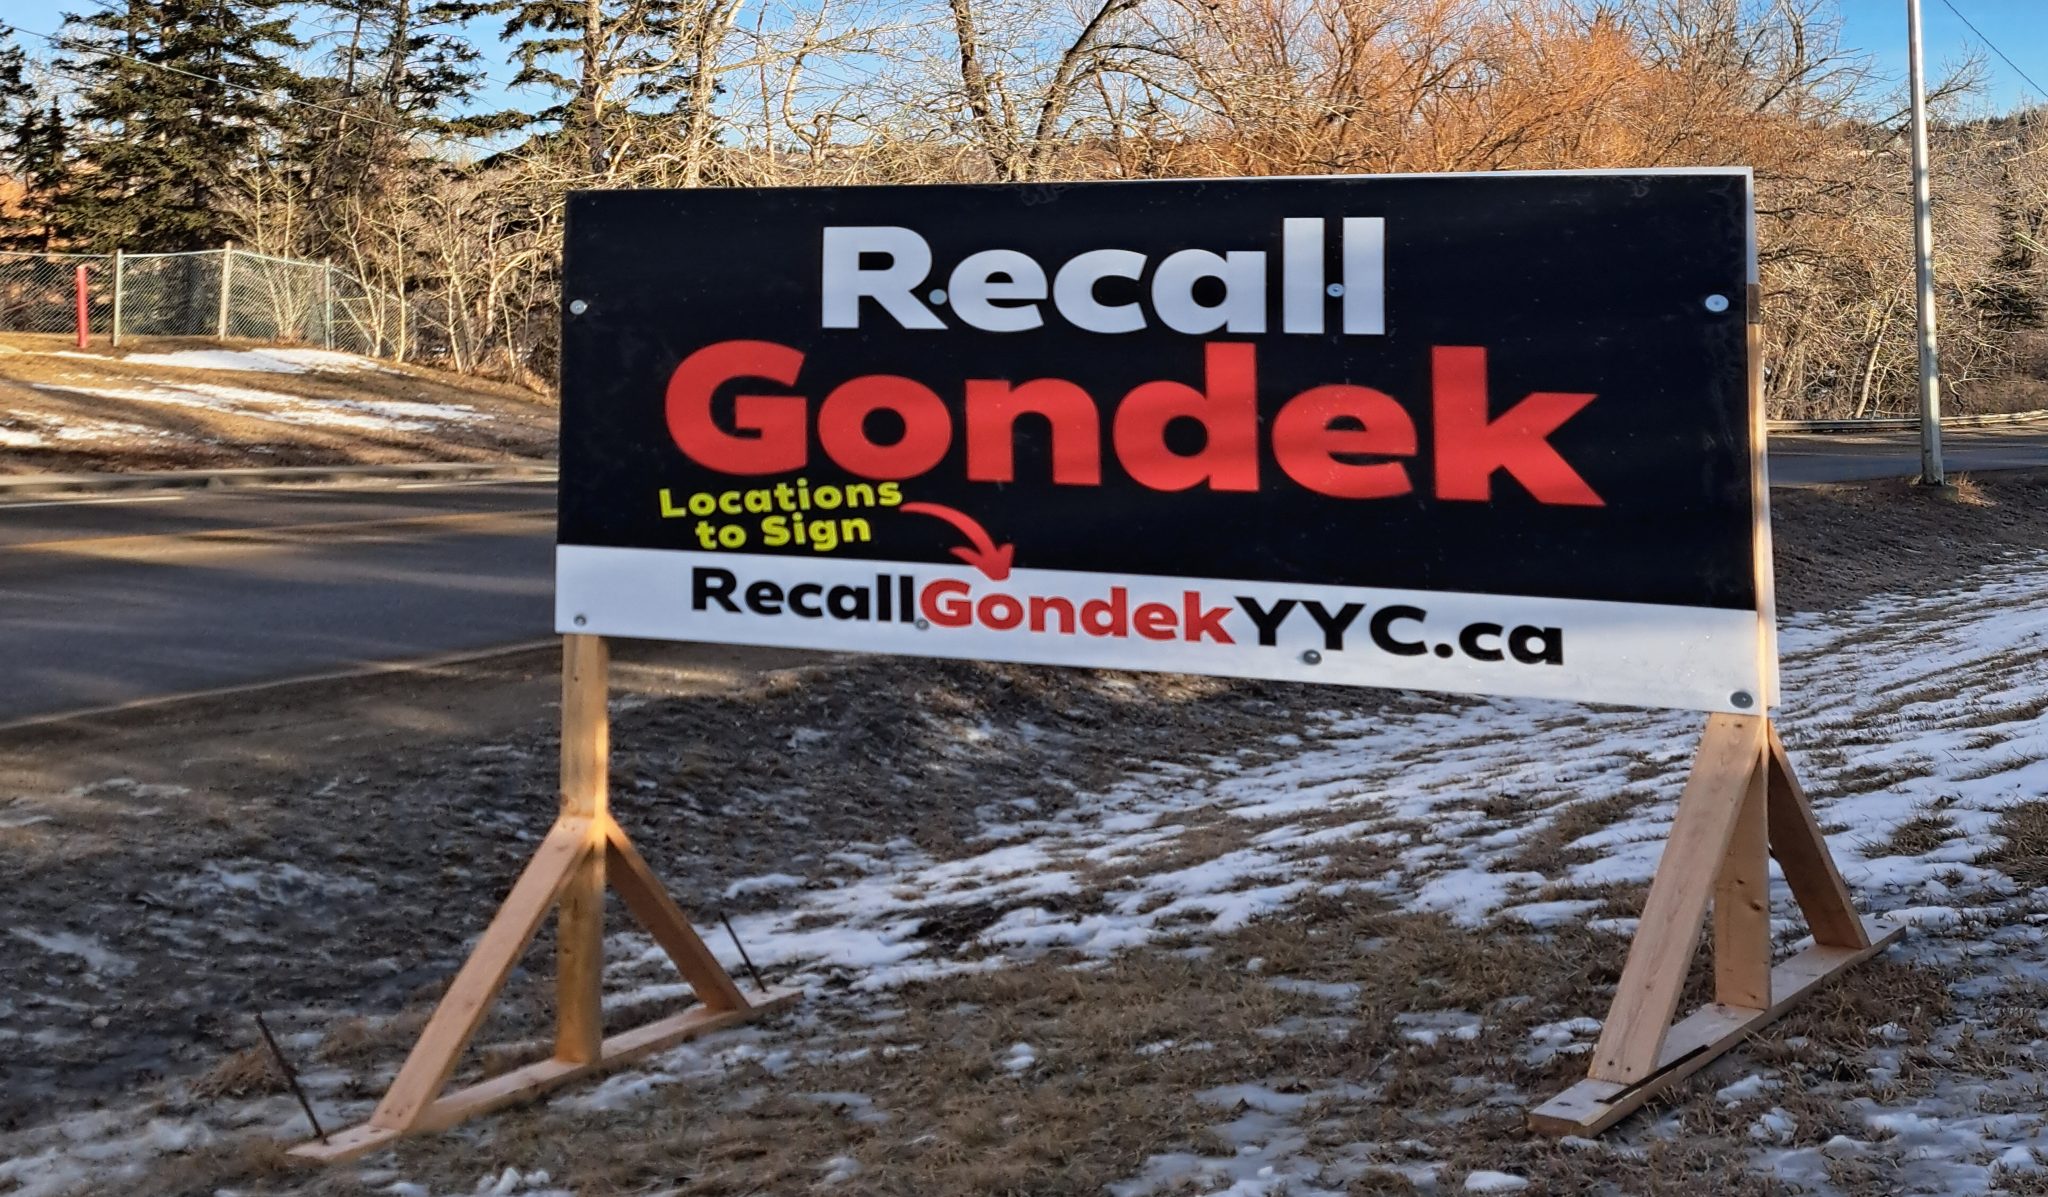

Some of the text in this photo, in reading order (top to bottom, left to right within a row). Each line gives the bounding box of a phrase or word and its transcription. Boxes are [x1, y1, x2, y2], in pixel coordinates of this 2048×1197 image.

[821, 217, 1385, 335] Recall
[664, 339, 1607, 507] Gondek
[659, 478, 903, 518] Locations
[695, 512, 872, 552] to Sign
[691, 567, 1564, 665] RecallGondekYYC.ca
